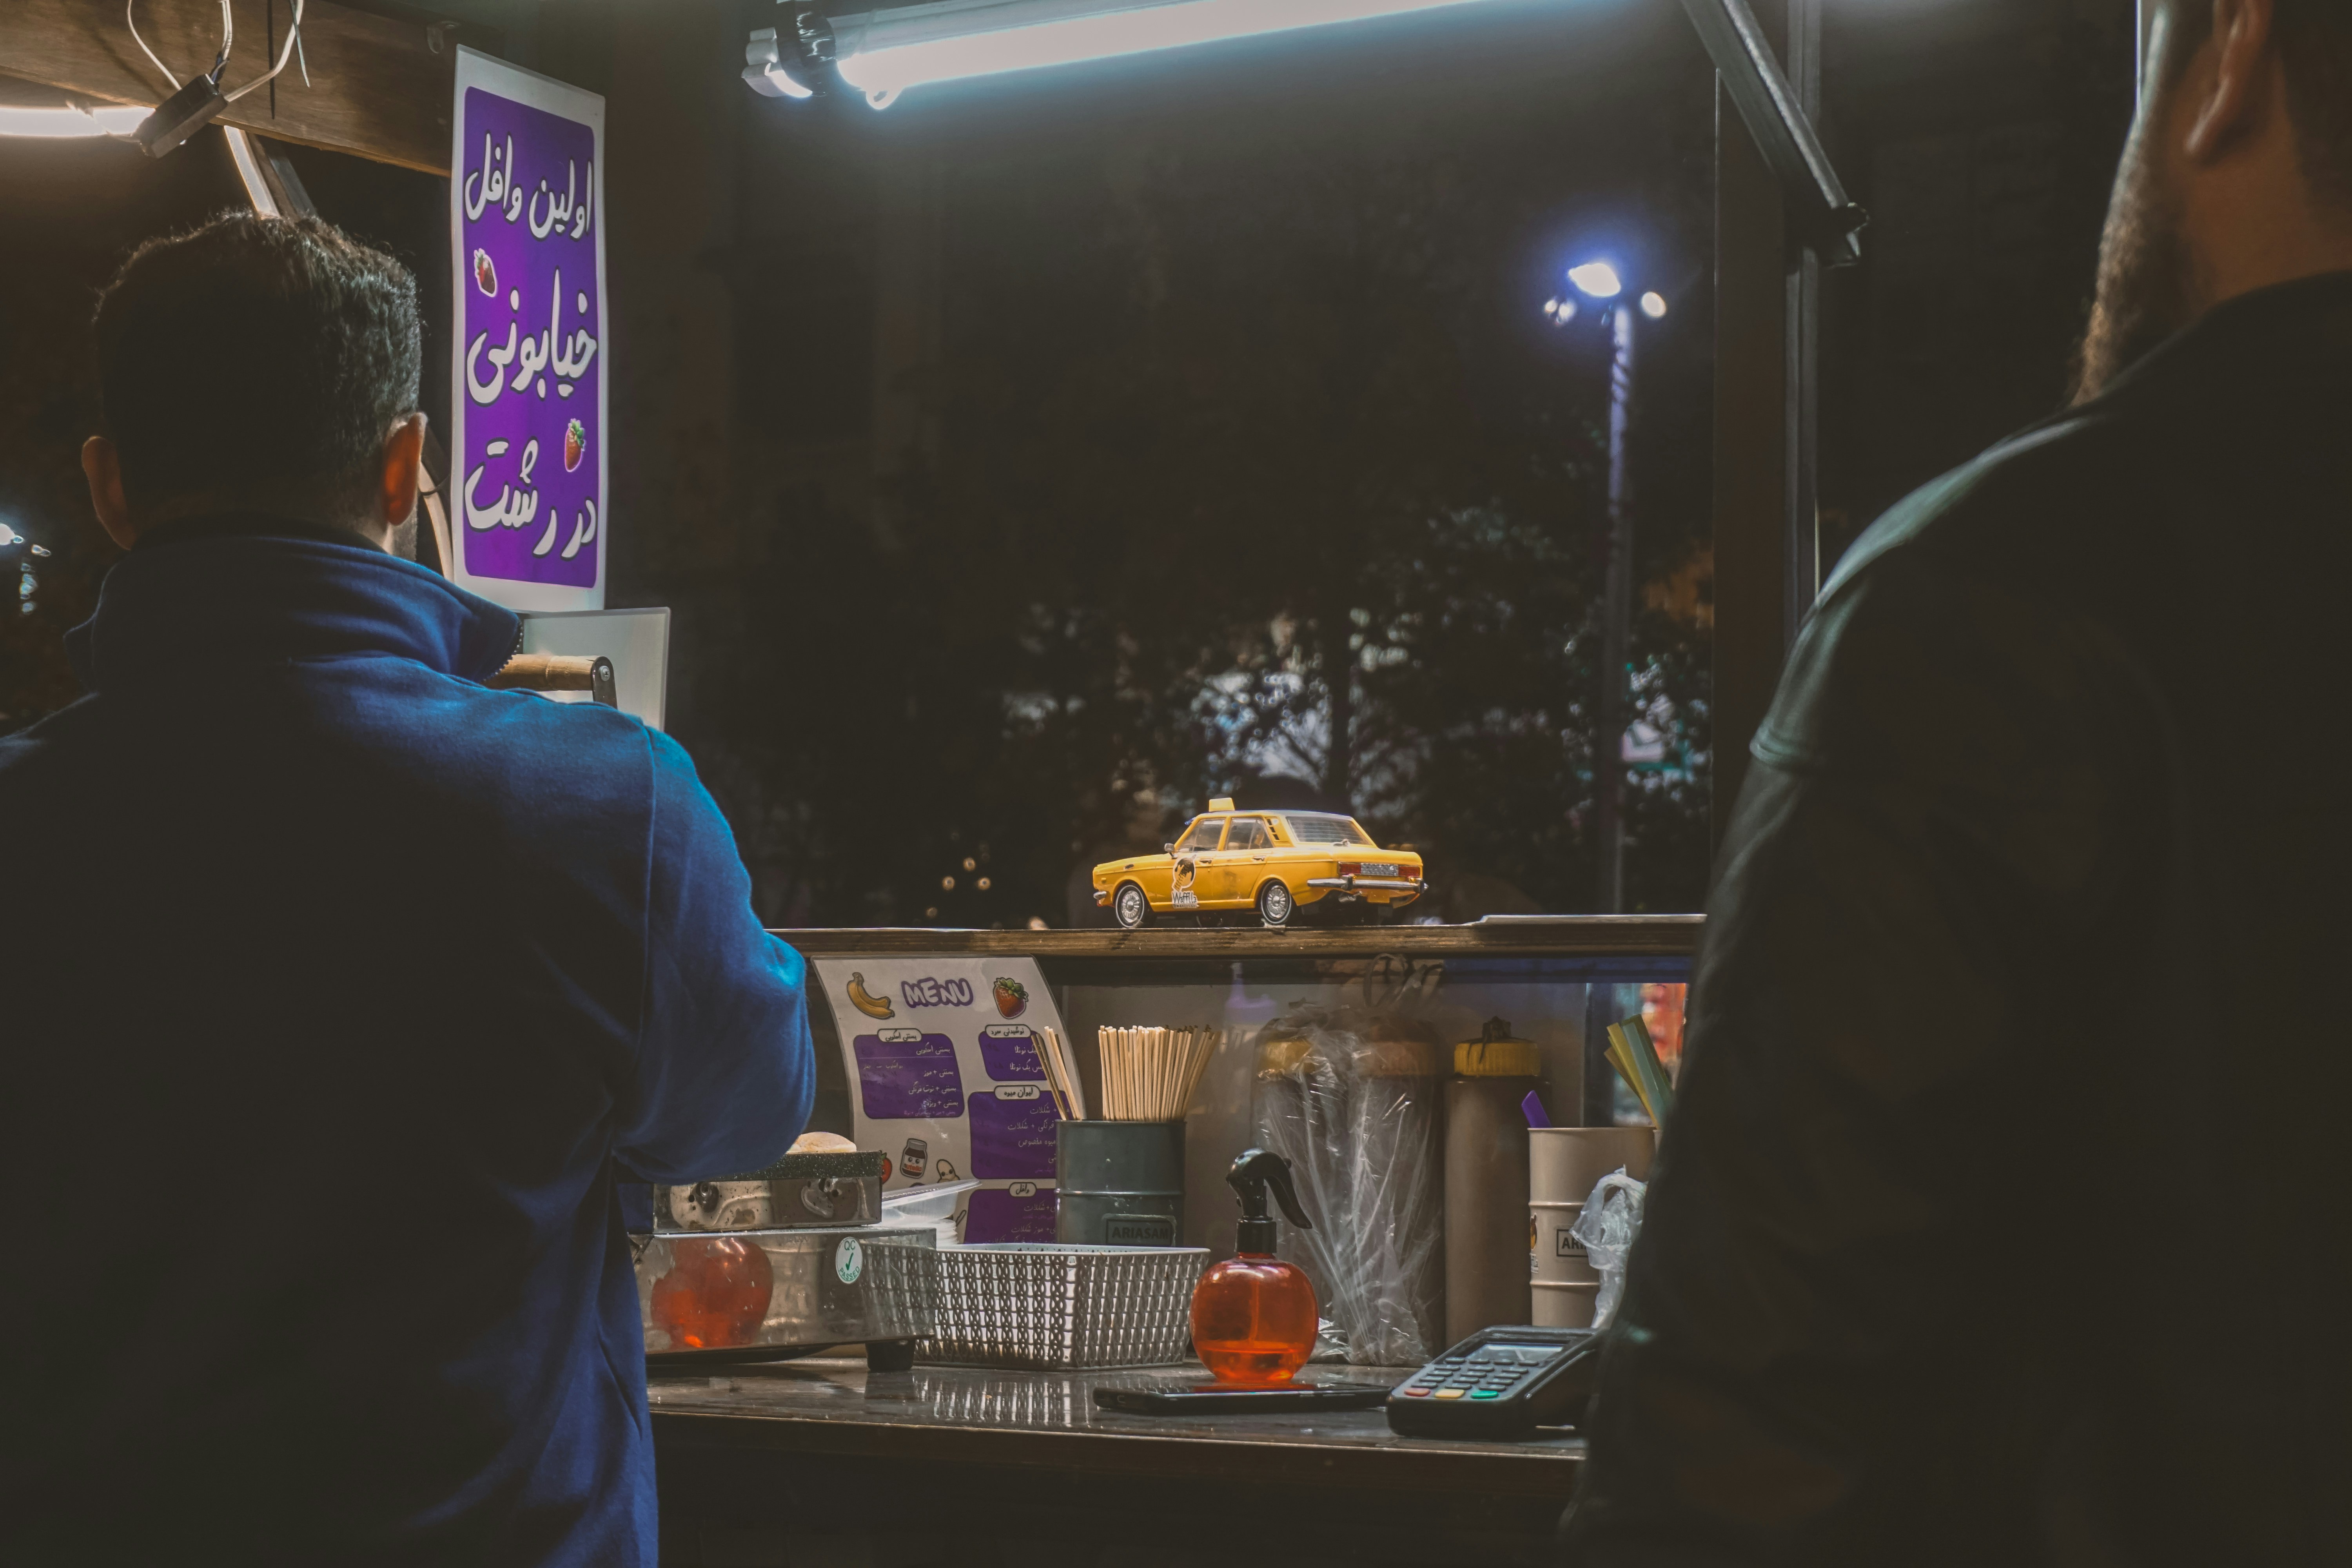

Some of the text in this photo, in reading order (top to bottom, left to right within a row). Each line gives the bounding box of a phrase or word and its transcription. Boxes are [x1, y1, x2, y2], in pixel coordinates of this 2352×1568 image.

[464, 131, 593, 240] اولین وافل
[466, 267, 598, 405] خیابونی
[561, 498, 597, 559] در
[901, 977, 973, 1008] MENU
[1003, 1026, 1024, 1036] نوشیدنی
[902, 1033, 917, 1042] بستنی
[935, 1046, 950, 1055] بستنی
[1014, 1045, 1026, 1055] نوتلا
[1009, 1062, 1021, 1072] نوتلا
[938, 1069, 954, 1078] بستنی
[908, 1080, 922, 1095] فرنگی
[941, 1085, 956, 1094] بستنی
[1017, 1087, 1033, 1098] لیوان
[943, 1099, 959, 1108] بستنی
[1029, 1102, 1051, 1114] شکلات
[1007, 1118, 1029, 1130] شکلات
[1018, 1137, 1042, 1147] مخصوص
[1015, 1183, 1030, 1195] وافل
[1024, 1199, 1045, 1211] شکلات
[1011, 1222, 1032, 1233] شکلات
[1112, 1226, 1169, 1240] ARIASAM
[844, 1239, 856, 1251] QC
[839, 1265, 860, 1280] PASSED
